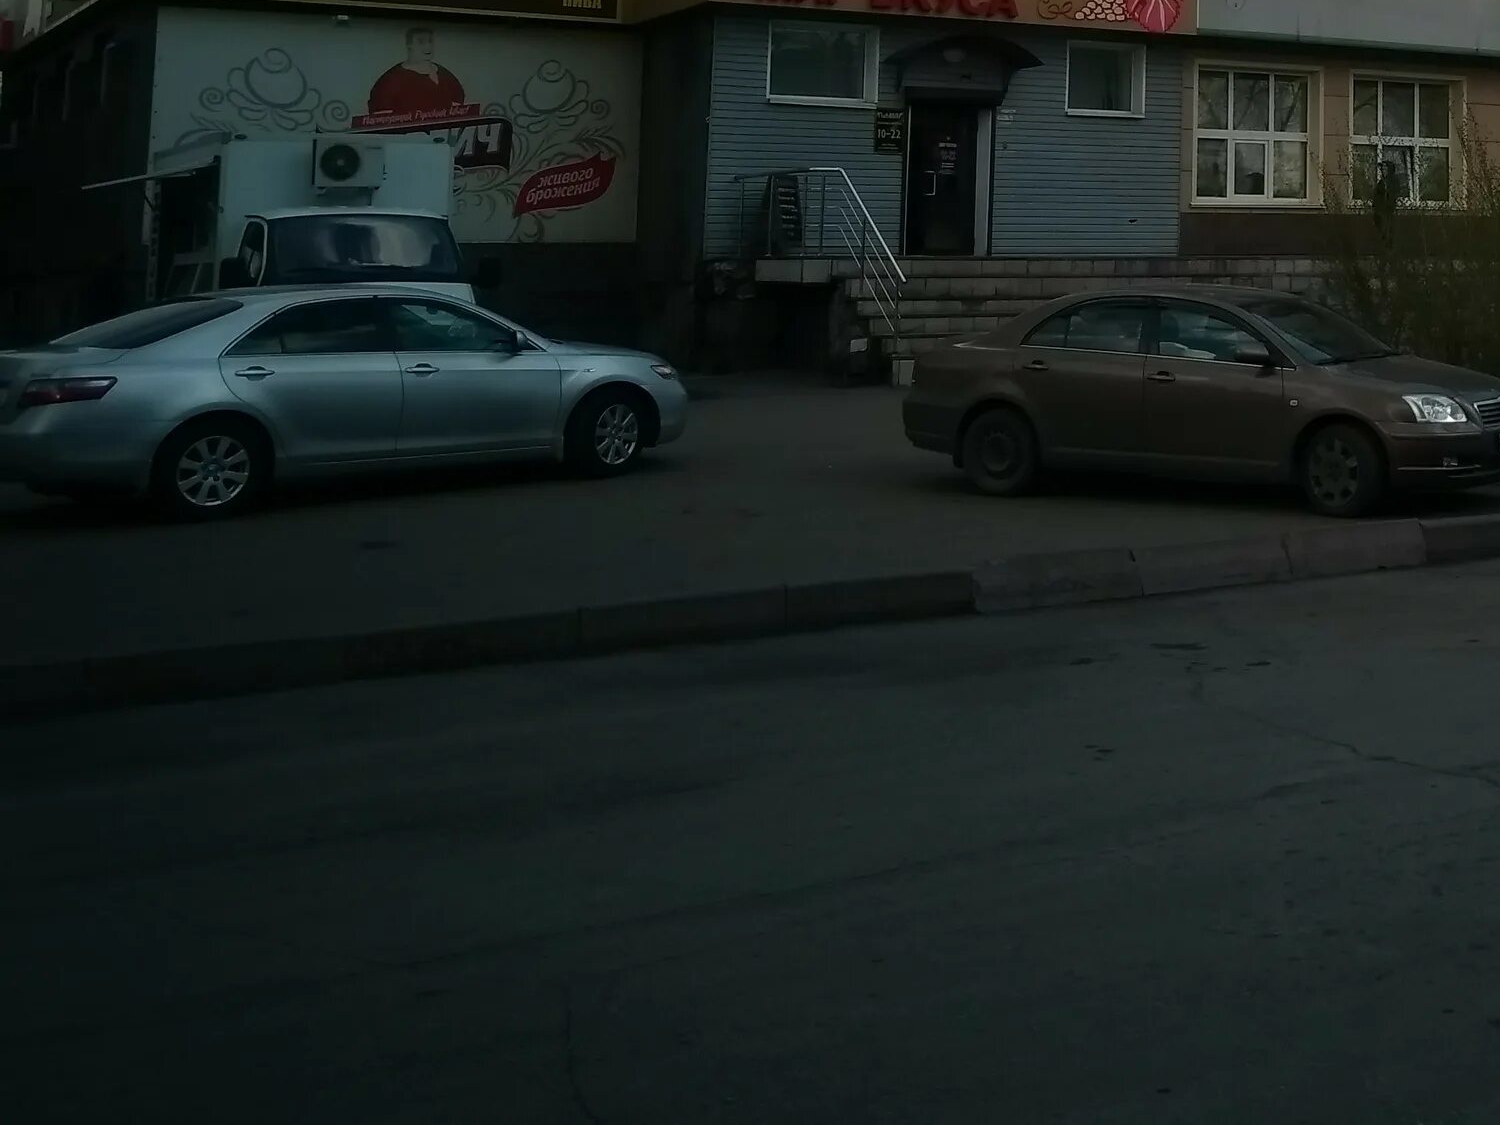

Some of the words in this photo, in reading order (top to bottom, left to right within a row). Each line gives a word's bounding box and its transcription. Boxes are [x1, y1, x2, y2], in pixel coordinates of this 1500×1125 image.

[877, 128, 901, 139] 10-22
[538, 168, 594, 188] живого
[526, 177, 600, 205] брожения
